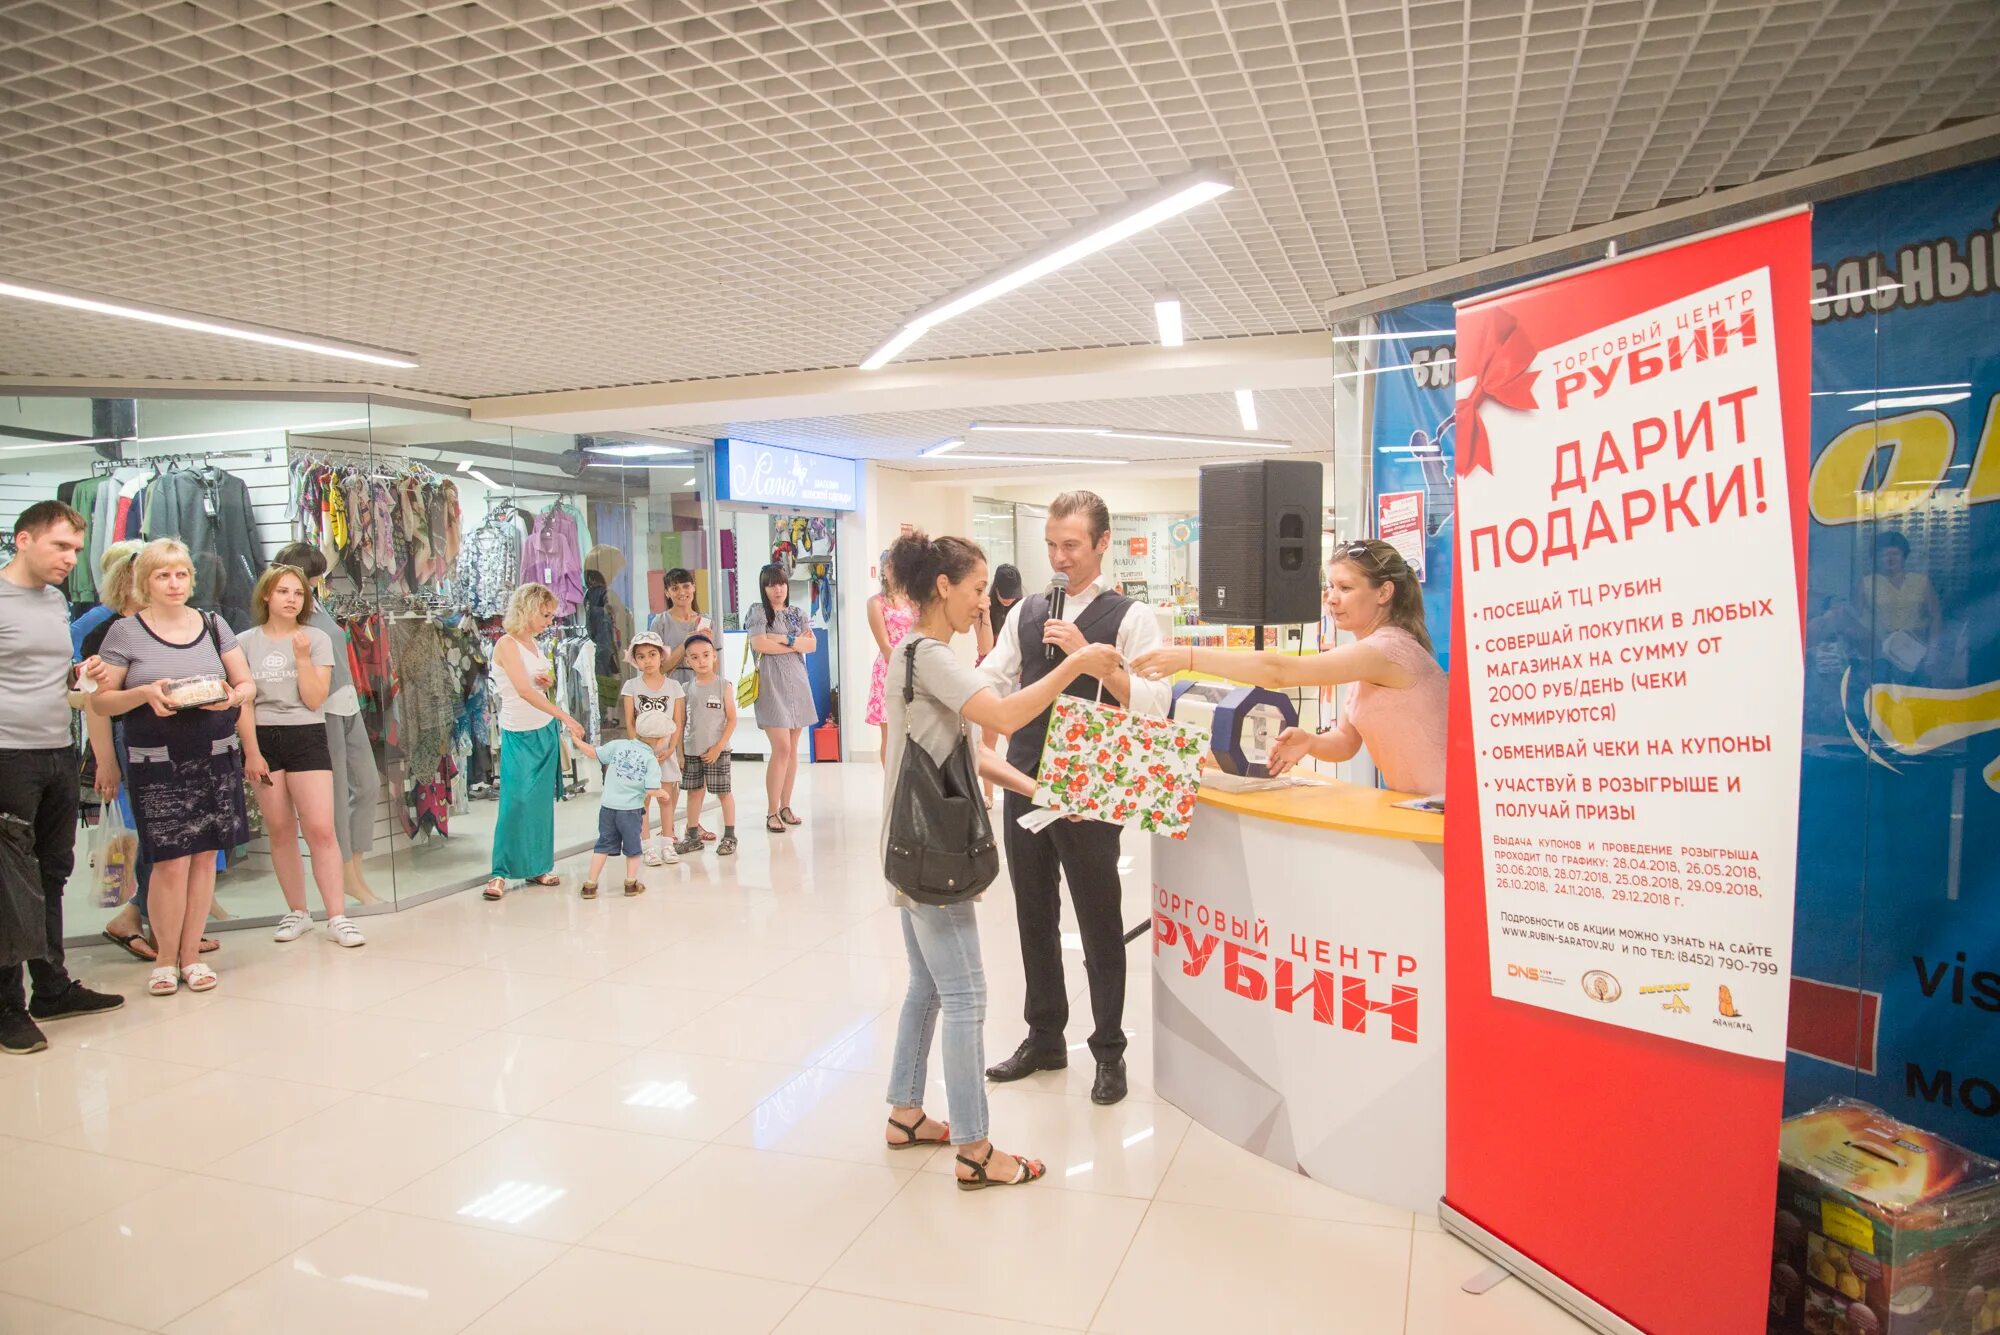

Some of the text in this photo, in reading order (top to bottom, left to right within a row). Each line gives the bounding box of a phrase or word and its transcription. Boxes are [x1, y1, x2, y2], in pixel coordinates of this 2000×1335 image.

[1812, 232, 2000, 321] ЕЛЬНЫ
[1553, 289, 1753, 374] ТОРГОВЫЙ ЦЕНТР
[1555, 308, 1757, 410] РУБИН
[1551, 386, 1758, 501] ДАРИТ
[1470, 457, 1767, 572] ПОДАРКИ!
[1483, 577, 1662, 621] ПОСЕЩАЙ ТЦ РУБИН
[1485, 598, 1775, 653] СОВЕРШАЙ ПОКУПКИ В ЛЮБЫХ
[1487, 636, 1723, 678] МАГАЗИНАХ НА СУММУ ОТ
[1489, 670, 1687, 703] 2000 РУБ/ДЕНЬ (ЧЕКИ
[1490, 703, 1617, 728] СУММИРУЮТСЯ)
[1492, 734, 1772, 760] ОБМЕНИВАЙ ЧЕКИ НА КУПОНЫ
[1494, 773, 1741, 793] УЧАСТВУЙ В РОЗЫГРЫШЕ И
[1495, 799, 1636, 821] ПОЛУЧАЙ ПРИЗЫ
[1493, 835, 1759, 861] ВЫДАЧА КУПОНОВ И ПРОВЕДЕНИЕ РОЗЫГРЫША
[1494, 851, 1761, 880] ПРОХОДИТ ПО ГРАФИКУ: 28.04.2018, 26.05.2018,
[1495, 863, 1763, 898] 30.06.2018, 28.07.2018, 25.08.2018, 29.09.2018,
[1497, 878, 1548, 893] 26.10.2018,
[1554, 883, 1605, 899] 24.11.2018,
[1611, 889, 1670, 905] 29.12.2018
[1152, 882, 1417, 977] ТОРГОВЫЙ ЦЕНТР
[1501, 911, 1773, 958] ПОДРОБНОСТИ ОБ АКЦИИ МОЖНО УЗНАТЬ НА САЙТЕ
[1502, 927, 1778, 976] WWW.RUBIN-SARATOV.RU И ПО ТЕЛ: (8452) 790-799
[1507, 964, 1539, 981] DNS
[1152, 909, 1418, 1044] РУБИН
